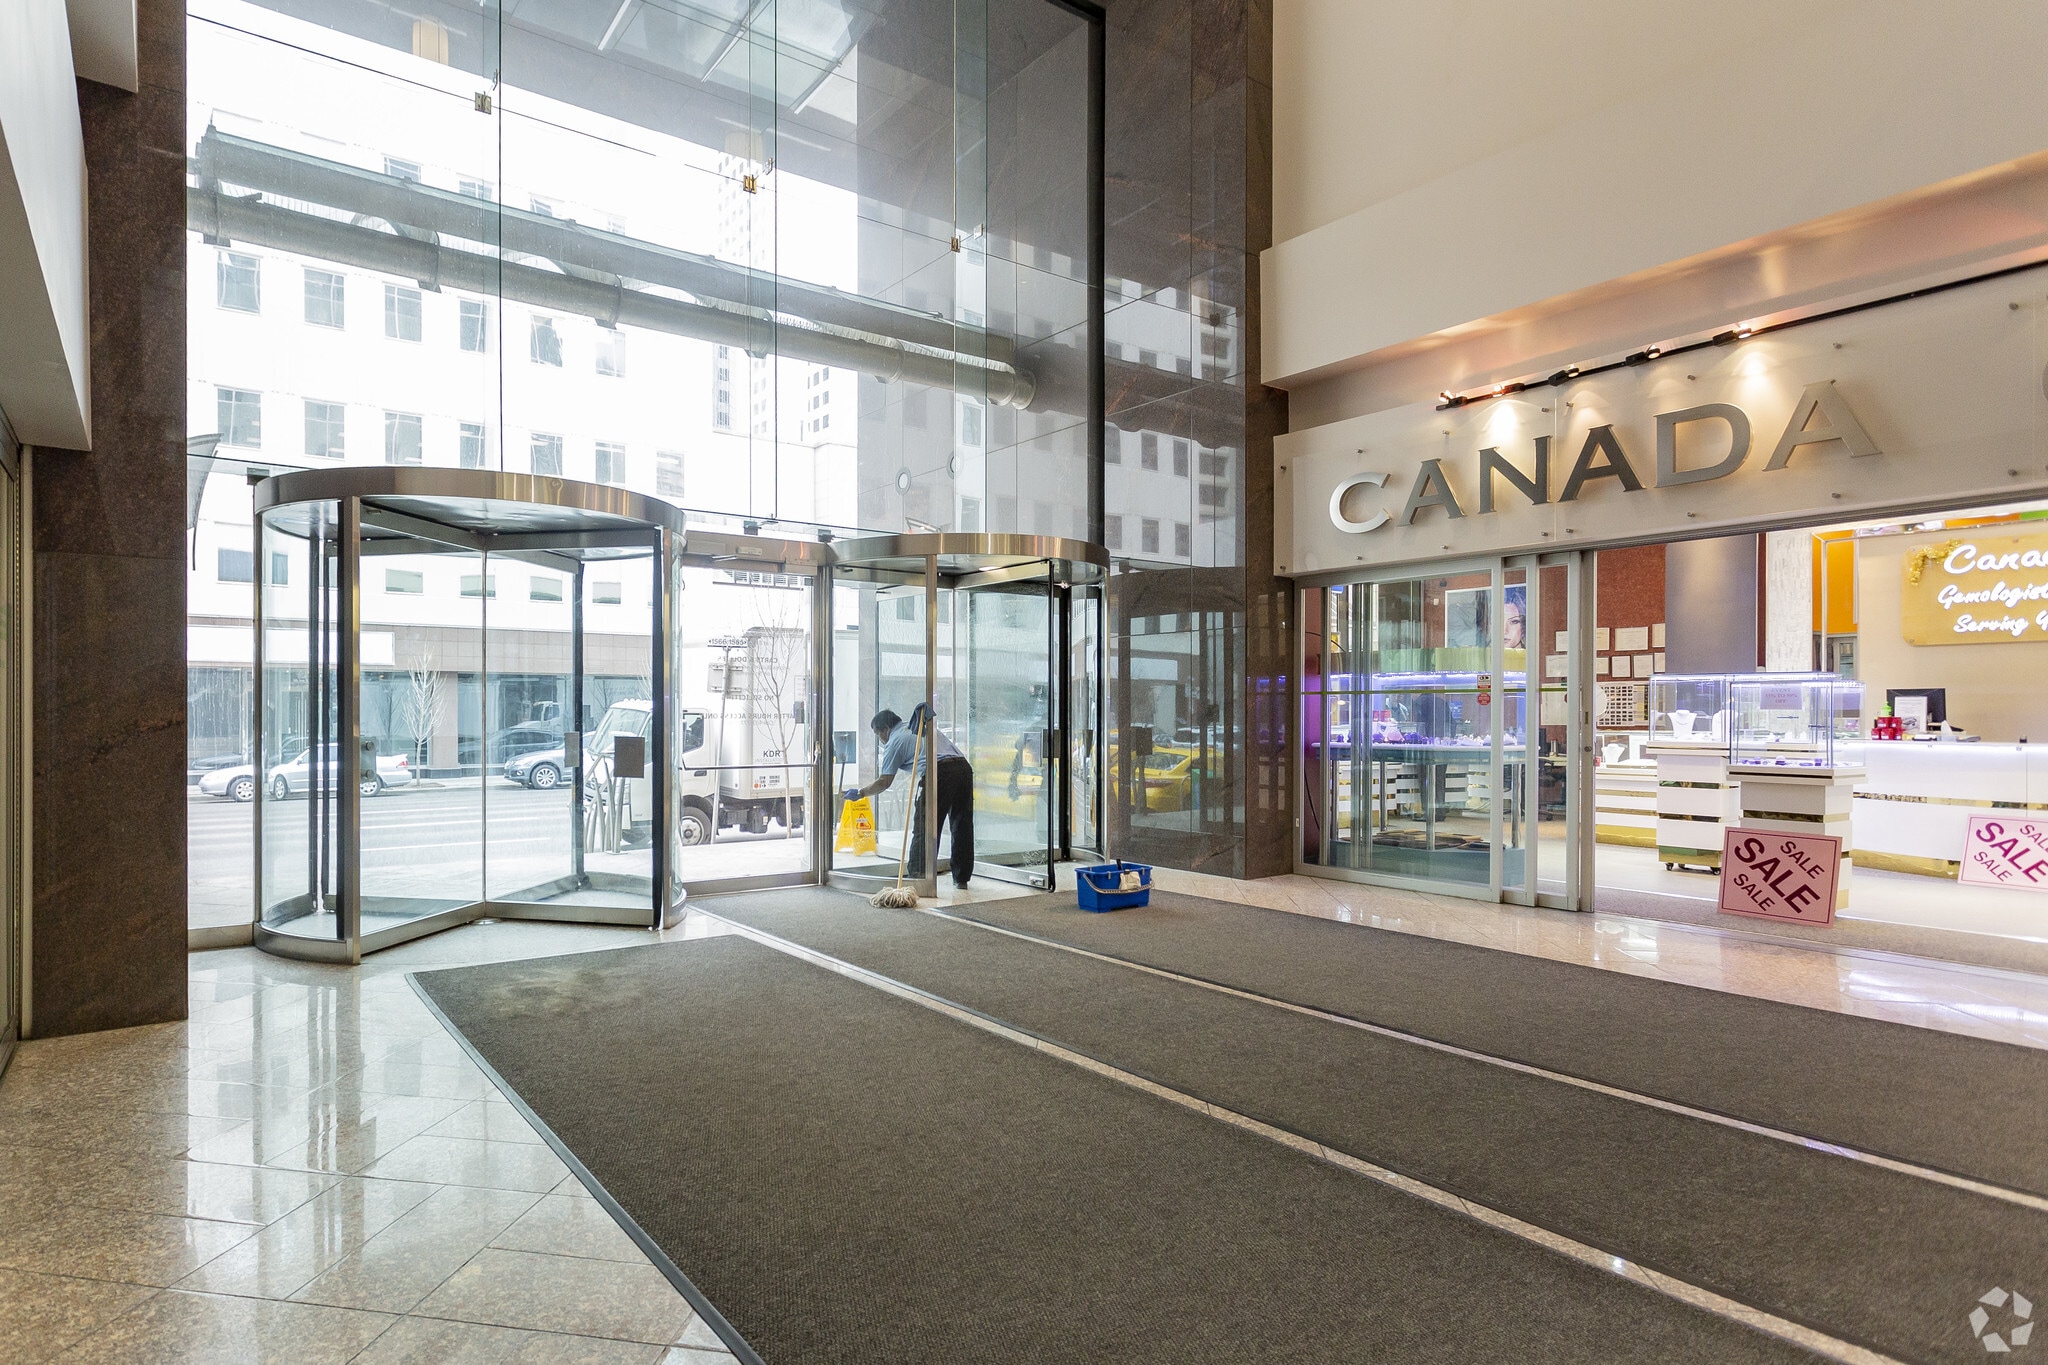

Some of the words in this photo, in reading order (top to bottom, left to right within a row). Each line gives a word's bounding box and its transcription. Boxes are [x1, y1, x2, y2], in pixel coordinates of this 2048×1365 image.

[1329, 379, 1882, 535] CANADA
[1943, 544, 2048, 575] Cana
[1953, 614, 2029, 637] Serving
[763, 750, 781, 758] KDR
[1780, 841, 1825, 879] SALE
[1973, 851, 2013, 882] SALE
[1975, 822, 2048, 883] SALE
[1733, 873, 1776, 911] SALE
[1734, 838, 1821, 914] SALE
